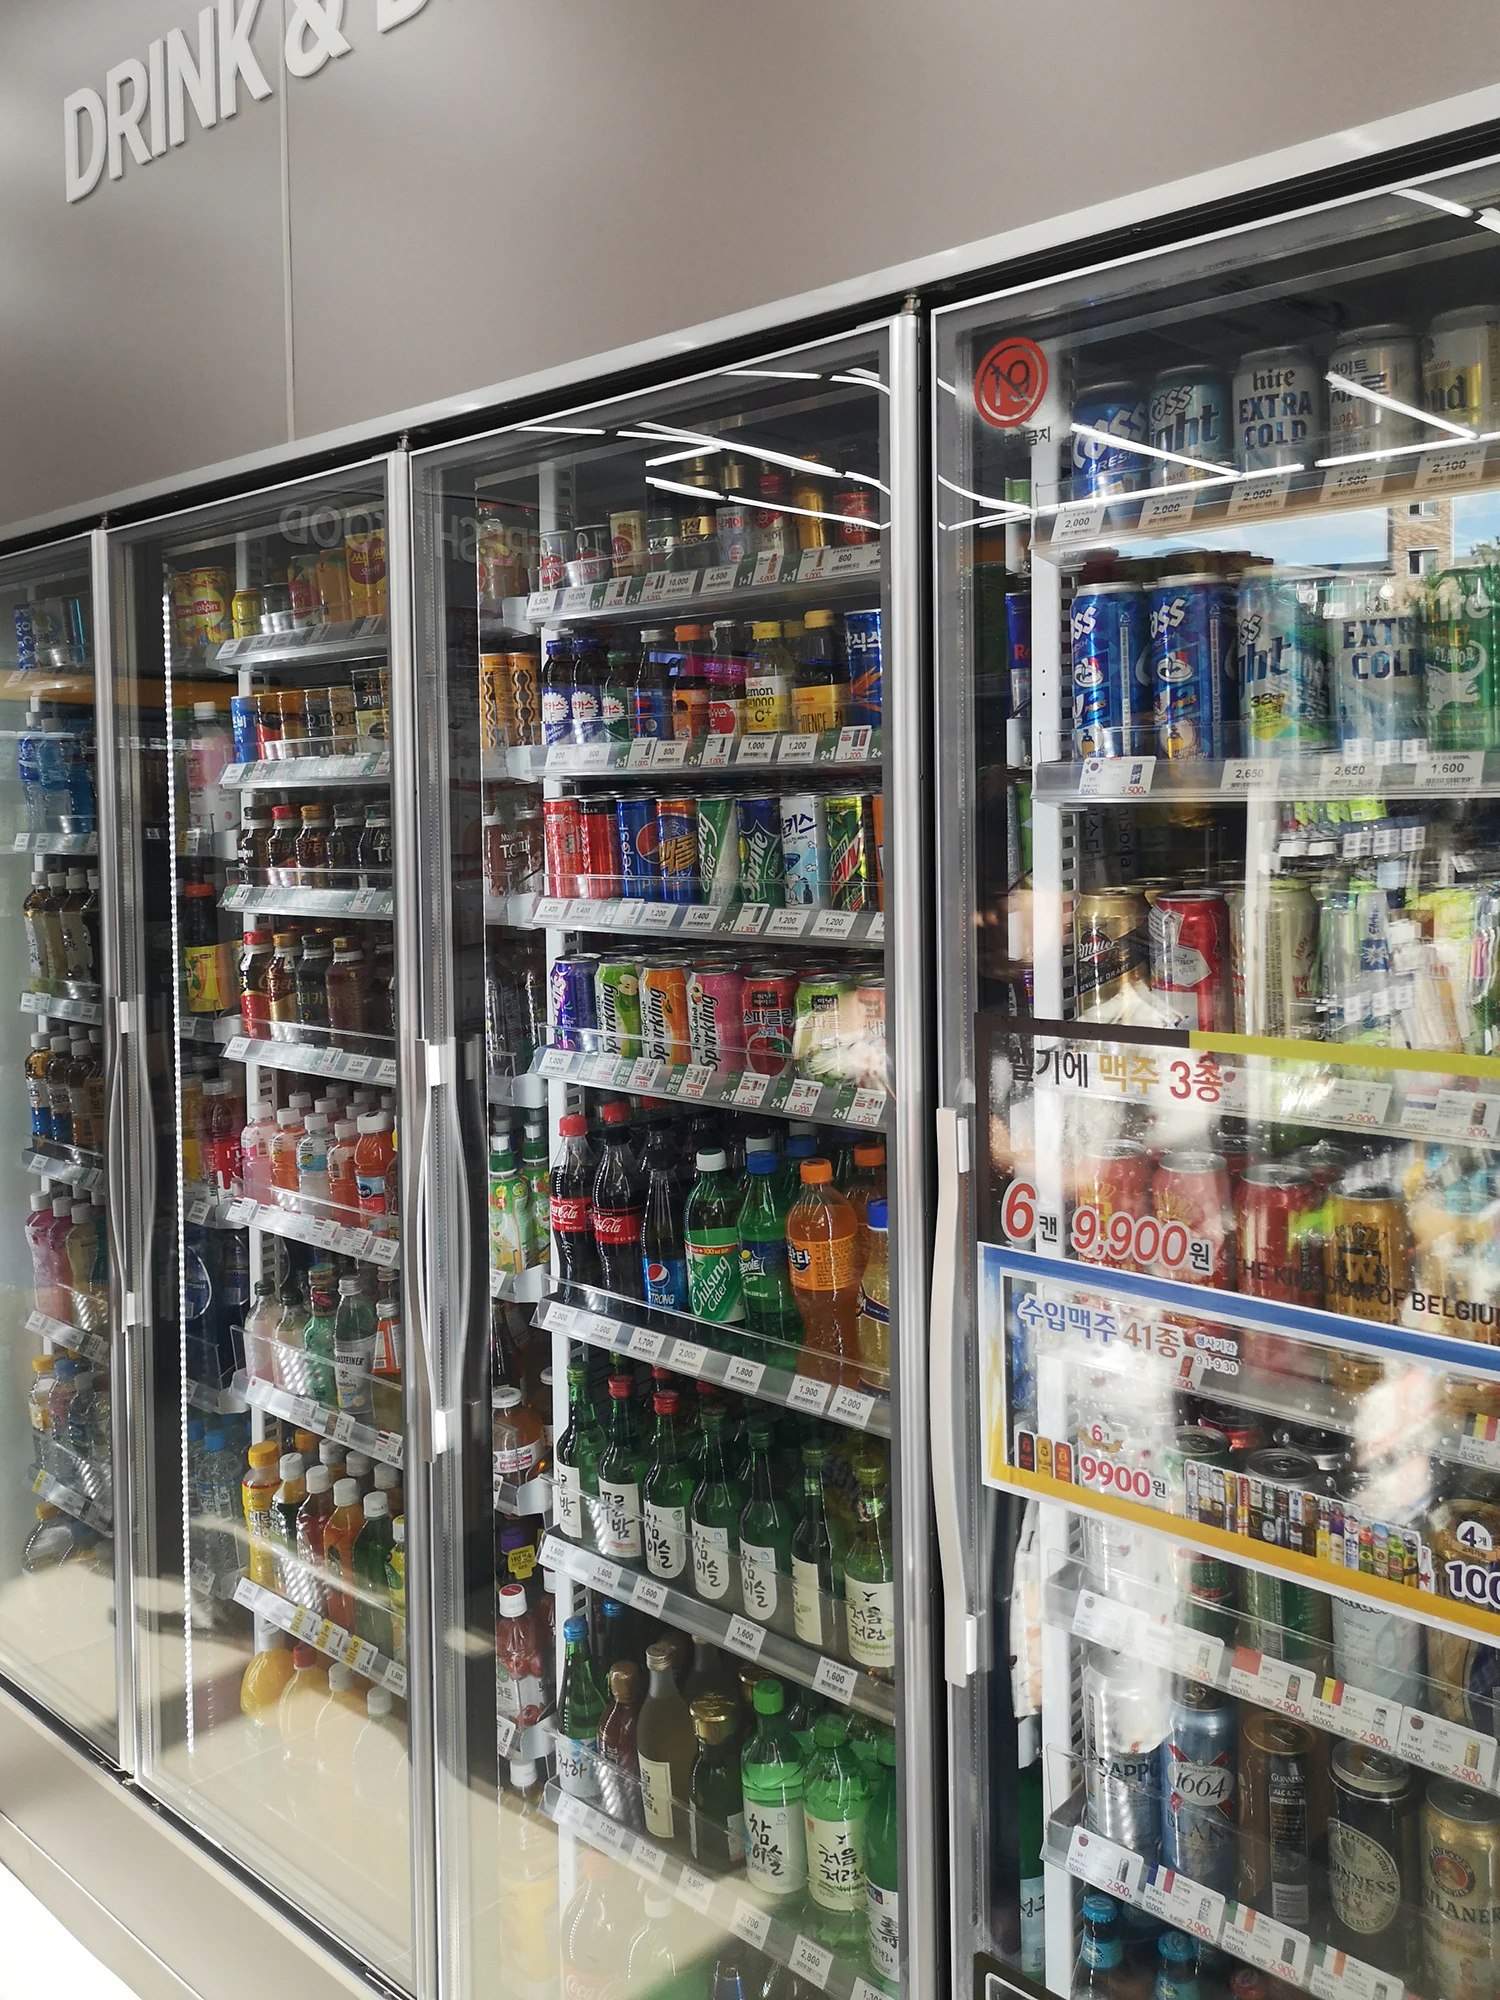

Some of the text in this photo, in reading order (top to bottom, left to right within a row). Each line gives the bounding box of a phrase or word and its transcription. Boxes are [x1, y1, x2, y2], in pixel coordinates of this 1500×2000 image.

[64, 0, 352, 204] DRINK &
[1251, 368, 1296, 393] hite
[1238, 390, 1312, 425] EXTRA
[1151, 403, 1220, 453] ight
[1243, 419, 1308, 451] COLD
[1432, 459, 1467, 474] 2,100
[1243, 488, 1273, 501] 2,000
[1152, 502, 1180, 515] 2,000
[1064, 516, 1090, 529] 2,000
[838, 553, 852, 563] 600
[668, 577, 689, 587] 10,000
[709, 572, 728, 581] 4,500
[738, 571, 753, 586] 1+1
[782, 568, 798, 583] 2+1
[1150, 598, 1186, 639] ass
[746, 685, 774, 696] emon
[747, 741, 765, 750] 1,000
[788, 741, 807, 750] 1,200
[688, 752, 702, 766] 2+1
[820, 746, 835, 761] 2+1
[615, 755, 628, 768] 2+1
[1431, 762, 1464, 775] 1,600
[1235, 768, 1265, 779] 2,650
[1334, 765, 1366, 777] 2,650
[1120, 784, 1144, 795] 3,500
[619, 826, 634, 879] pepsi
[692, 912, 709, 920] 1,400
[778, 916, 797, 925] 1,200
[824, 917, 843, 927] 1,200
[718, 919, 735, 932] 2+1
[1077, 939, 1120, 963] Miller
[602, 983, 620, 1058] Sparkling
[743, 1008, 795, 1026] 스파클링
[802, 1014, 841, 1031] 스파클
[648, 987, 667, 1064] Sparkling
[699, 992, 719, 1072] Sparkling
[757, 1027, 777, 1037] 사과
[1099, 1053, 1160, 1095] 맥주
[1169, 1060, 1224, 1103] 3종
[720, 1090, 734, 1102] 2+1
[770, 1096, 786, 1109] 2+1
[832, 1106, 849, 1120] 2+1
[1346, 1112, 1376, 1125] 2,900
[1005, 1182, 1211, 1272] 6캔 9,900원
[691, 1255, 733, 1316] Chilsung
[706, 1277, 727, 1312] Cider
[1236, 1258, 1270, 1282] THE
[1411, 1291, 1500, 1330] BELGIU
[552, 1311, 569, 1322] 2,000
[594, 1323, 611, 1335] 2,000
[1021, 1298, 1182, 1359] 수입맥주 41종
[637, 1336, 654, 1347] 1,700
[1195, 1334, 1238, 1355] 행사기간
[678, 1349, 697, 1360] 2,000
[735, 1366, 754, 1378] 1,800
[840, 1397, 862, 1411] 2,000
[1080, 1456, 1167, 1499] 9900원
[641, 1586, 658, 1600] 1,600
[735, 1626, 754, 1641] 1,600
[825, 1669, 845, 1684] 1,600
[1275, 1698, 1302, 1718] 2,900
[1359, 1730, 1389, 1750] 2,900
[1452, 1763, 1483, 1785] 2,900
[1174, 1771, 1228, 1800] 1664
[749, 1813, 772, 1845] 참
[1166, 1814, 1225, 1842] BLAN
[752, 1842, 784, 1877] 이슬
[818, 1843, 857, 1867] 처음
[819, 1864, 864, 1884] 처럼
[1106, 1878, 1130, 1898] 2,900
[1186, 1918, 1211, 1939] 2,900
[800, 1950, 820, 1967] 2,800
[1269, 1958, 1297, 1980] 2,900
